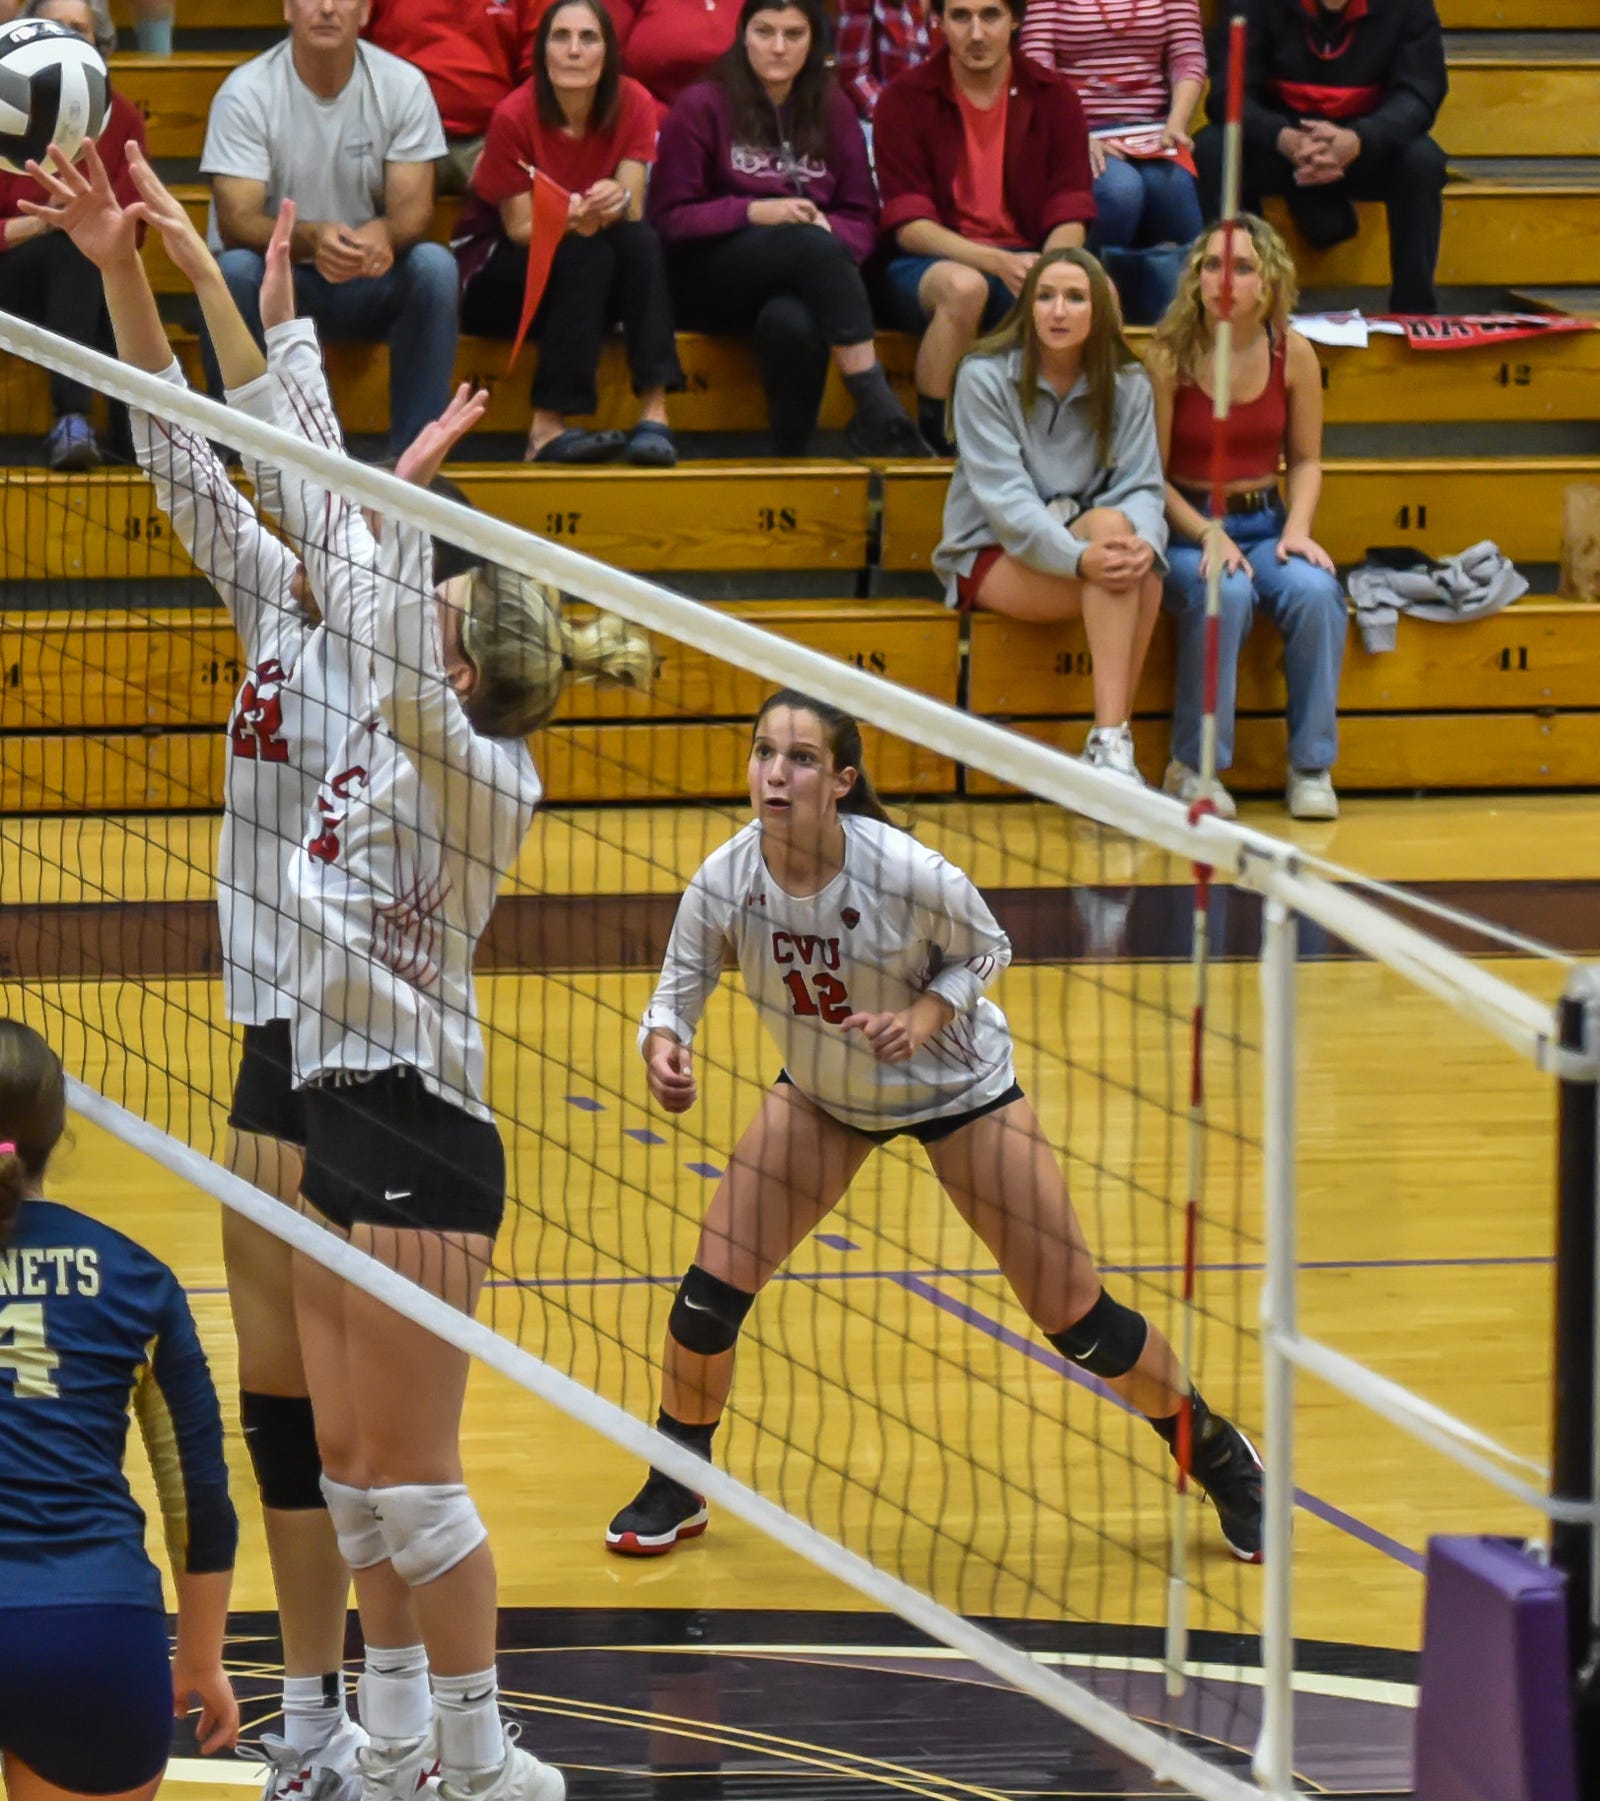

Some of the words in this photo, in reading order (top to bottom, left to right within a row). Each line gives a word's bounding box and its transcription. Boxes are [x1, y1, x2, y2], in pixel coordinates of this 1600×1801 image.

[545, 512, 582, 535] 37
[757, 508, 797, 531] 38
[1392, 505, 1426, 530] 41
[1494, 646, 1528, 672] 41
[772, 931, 840, 971] CVU
[783, 969, 853, 1024] 12
